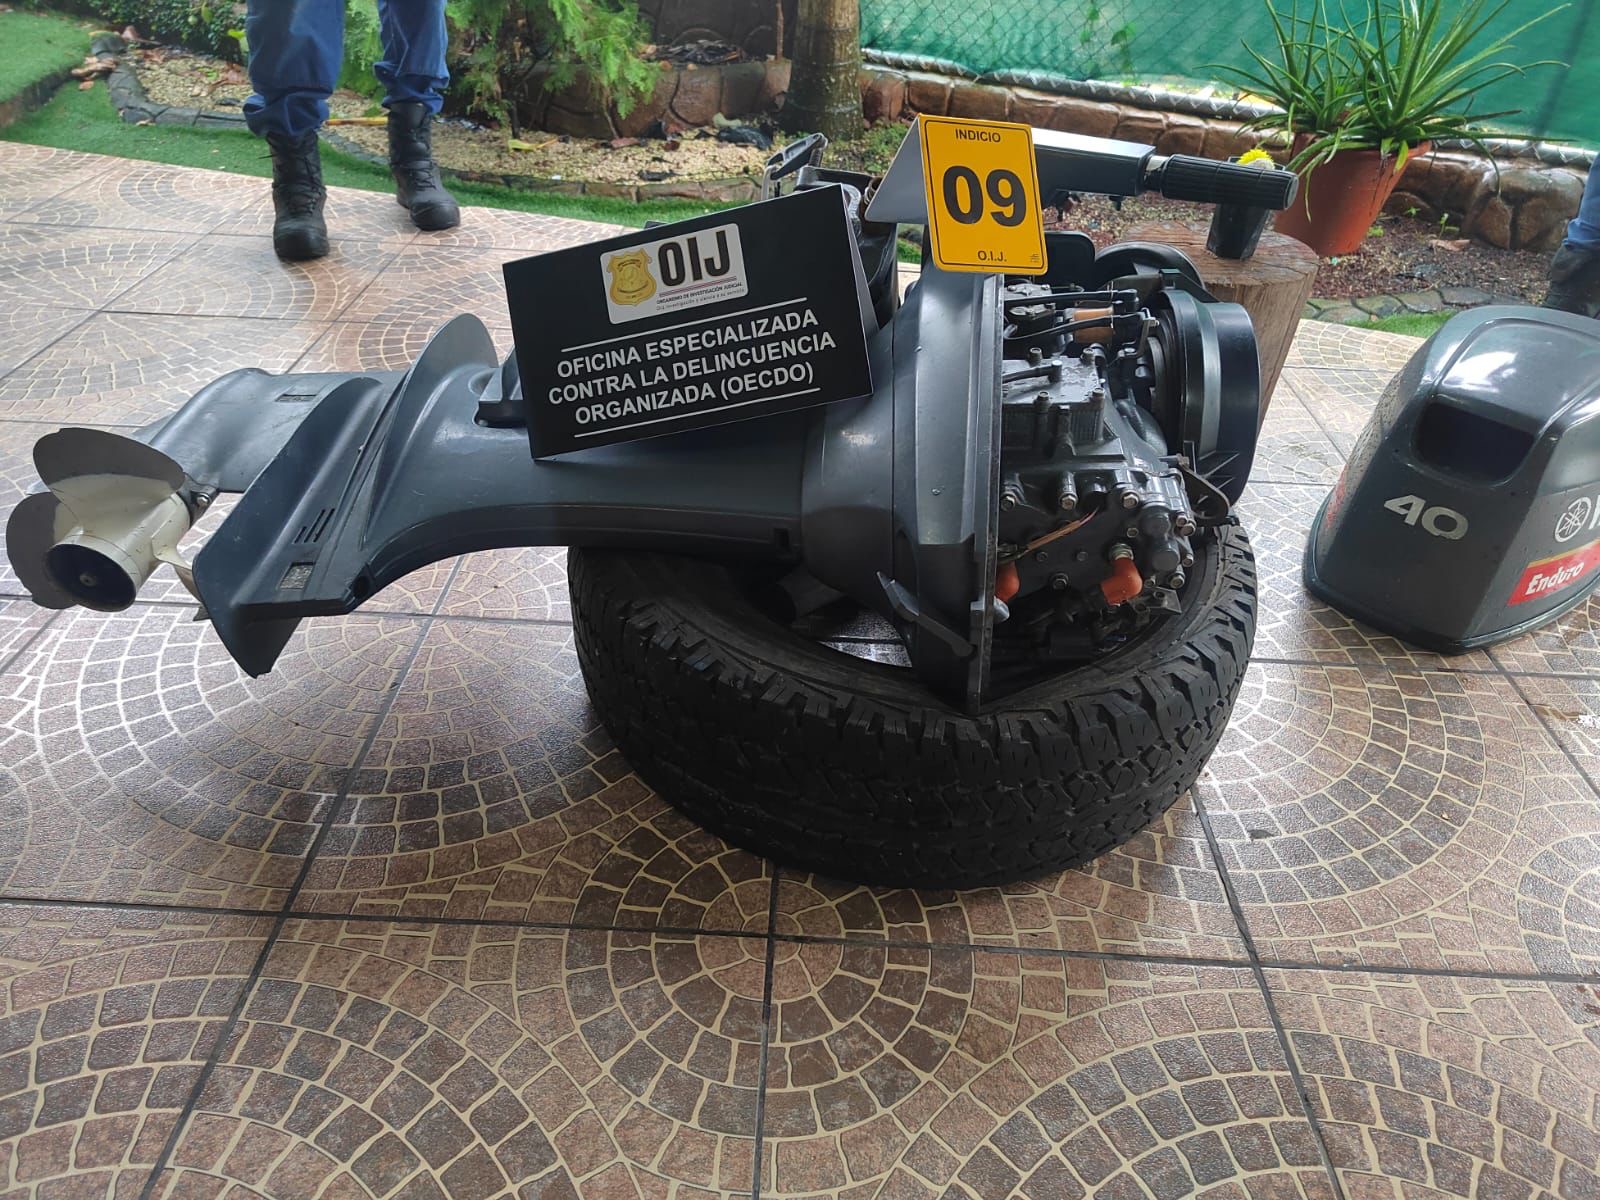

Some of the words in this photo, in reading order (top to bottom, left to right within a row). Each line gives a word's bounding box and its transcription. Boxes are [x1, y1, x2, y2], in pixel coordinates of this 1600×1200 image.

[955, 128, 1001, 143] INDICIO
[943, 165, 1027, 227] 09
[657, 230, 731, 287] OIJ
[977, 250, 1008, 263] O.I.J.
[548, 373, 635, 405] CONTRA
[641, 368, 669, 388] LA
[673, 331, 837, 381] DELINCUENCIA
[557, 347, 642, 378] OFICINA
[645, 308, 819, 361] ESPECIALIZADA
[575, 382, 716, 425] ORGANIZADA
[720, 361, 814, 401] (OECDO)
[1383, 494, 1470, 541] 40
[1525, 561, 1584, 596] Enduro
